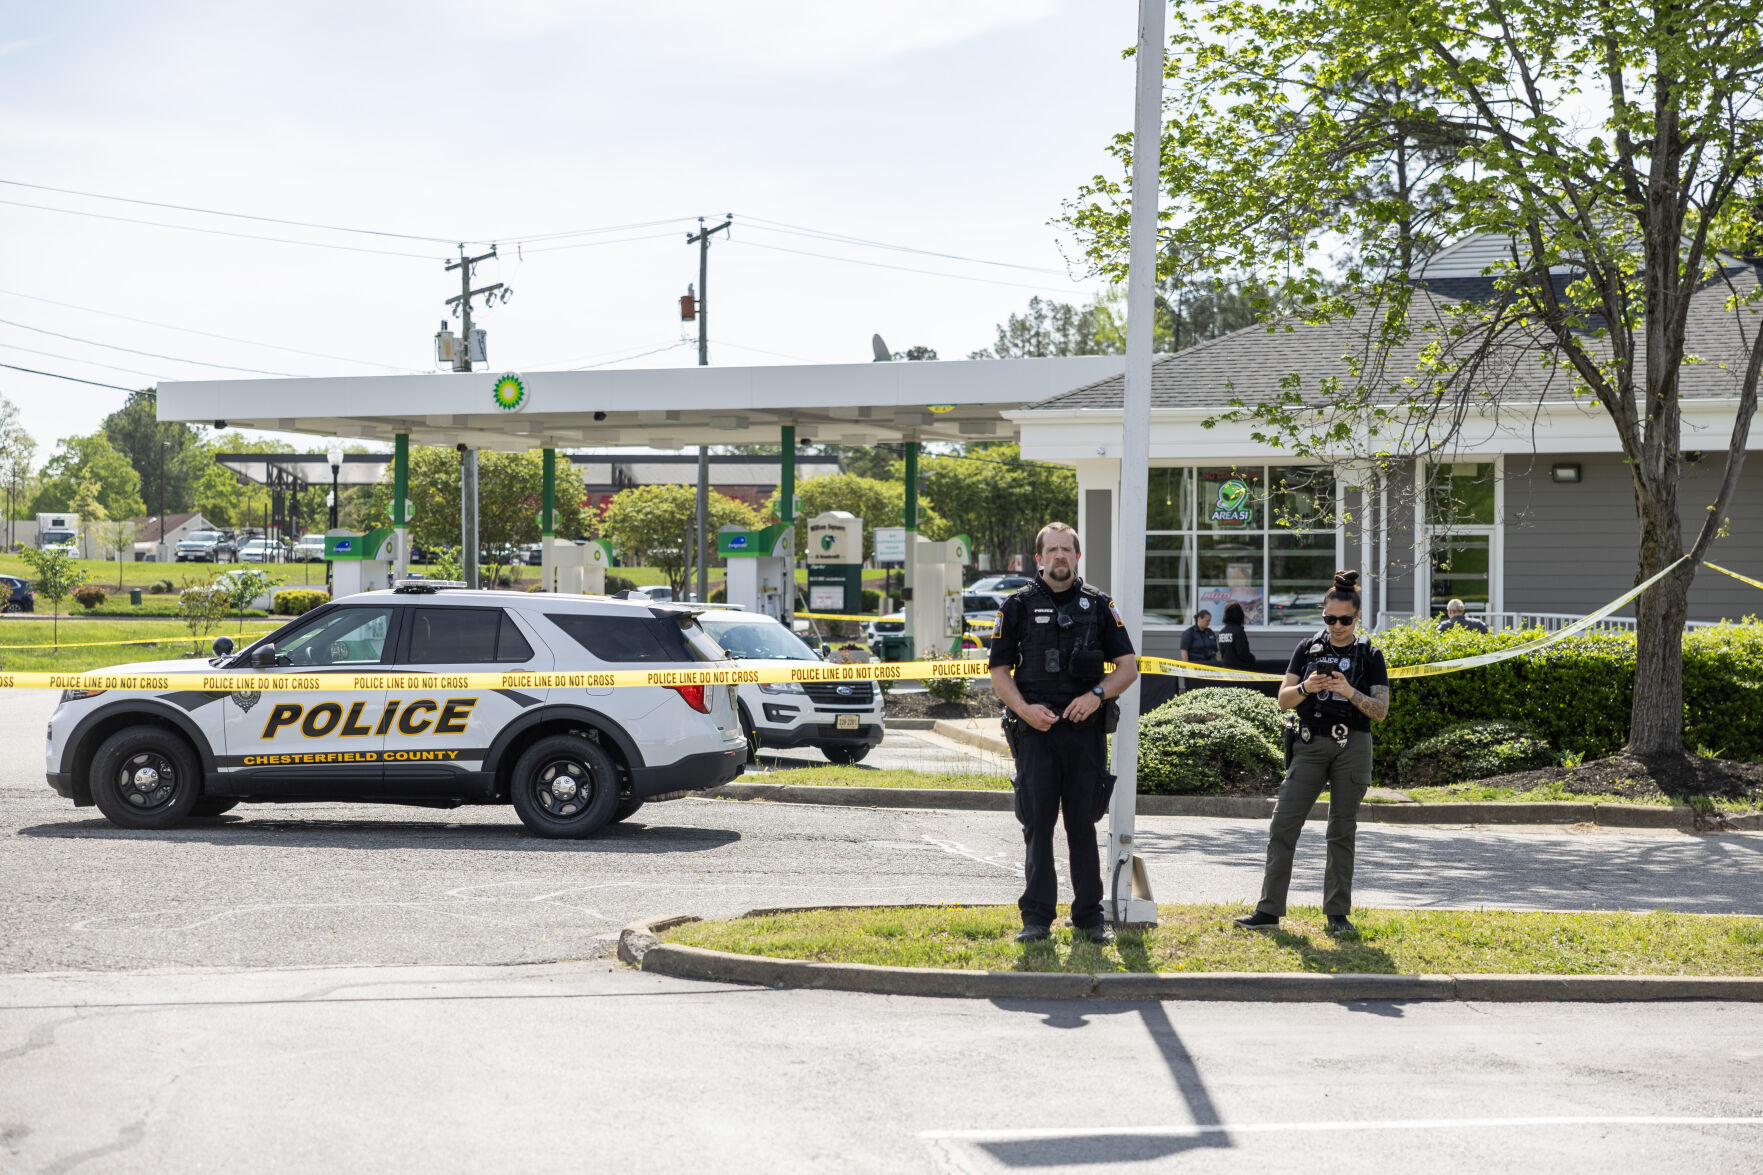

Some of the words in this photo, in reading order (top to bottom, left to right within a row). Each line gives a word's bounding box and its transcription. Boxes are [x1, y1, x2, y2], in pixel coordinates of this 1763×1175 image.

[791, 668, 820, 680] POLICE
[822, 668, 840, 680] LINE
[842, 667, 854, 679] DO
[856, 667, 872, 679] NOT
[874, 666, 901, 678] CROSS
[932, 664, 961, 676] POLICE
[963, 663, 981, 675] LINE
[50, 676, 81, 688] POLICE
[83, 676, 103, 689] LINE
[105, 677, 118, 689] DO
[120, 677, 138, 689] NOT
[140, 677, 169, 689] CROSS
[203, 677, 234, 689] POLICE
[236, 678, 255, 689] LINE
[258, 678, 270, 689] DO
[272, 678, 289, 690] NOT
[291, 678, 320, 690] CROSS
[354, 677, 384, 688] POLICE
[386, 677, 405, 689] LINE
[407, 677, 420, 689] DO
[421, 677, 438, 689] NOT
[440, 677, 469, 689] CROSS
[502, 676, 532, 688] POLICE
[534, 676, 552, 687] LINE
[554, 675, 566, 687] DO
[568, 675, 585, 686] NOT
[587, 674, 615, 686] CROSS
[647, 673, 677, 684] POLICE
[679, 672, 697, 684] LINE
[699, 672, 711, 683] DO
[713, 671, 729, 683] NOT
[731, 670, 759, 683] CROSS
[260, 697, 479, 740] POLICE
[243, 752, 378, 765] CHESTERFIELD
[383, 750, 460, 761] COUNTY
